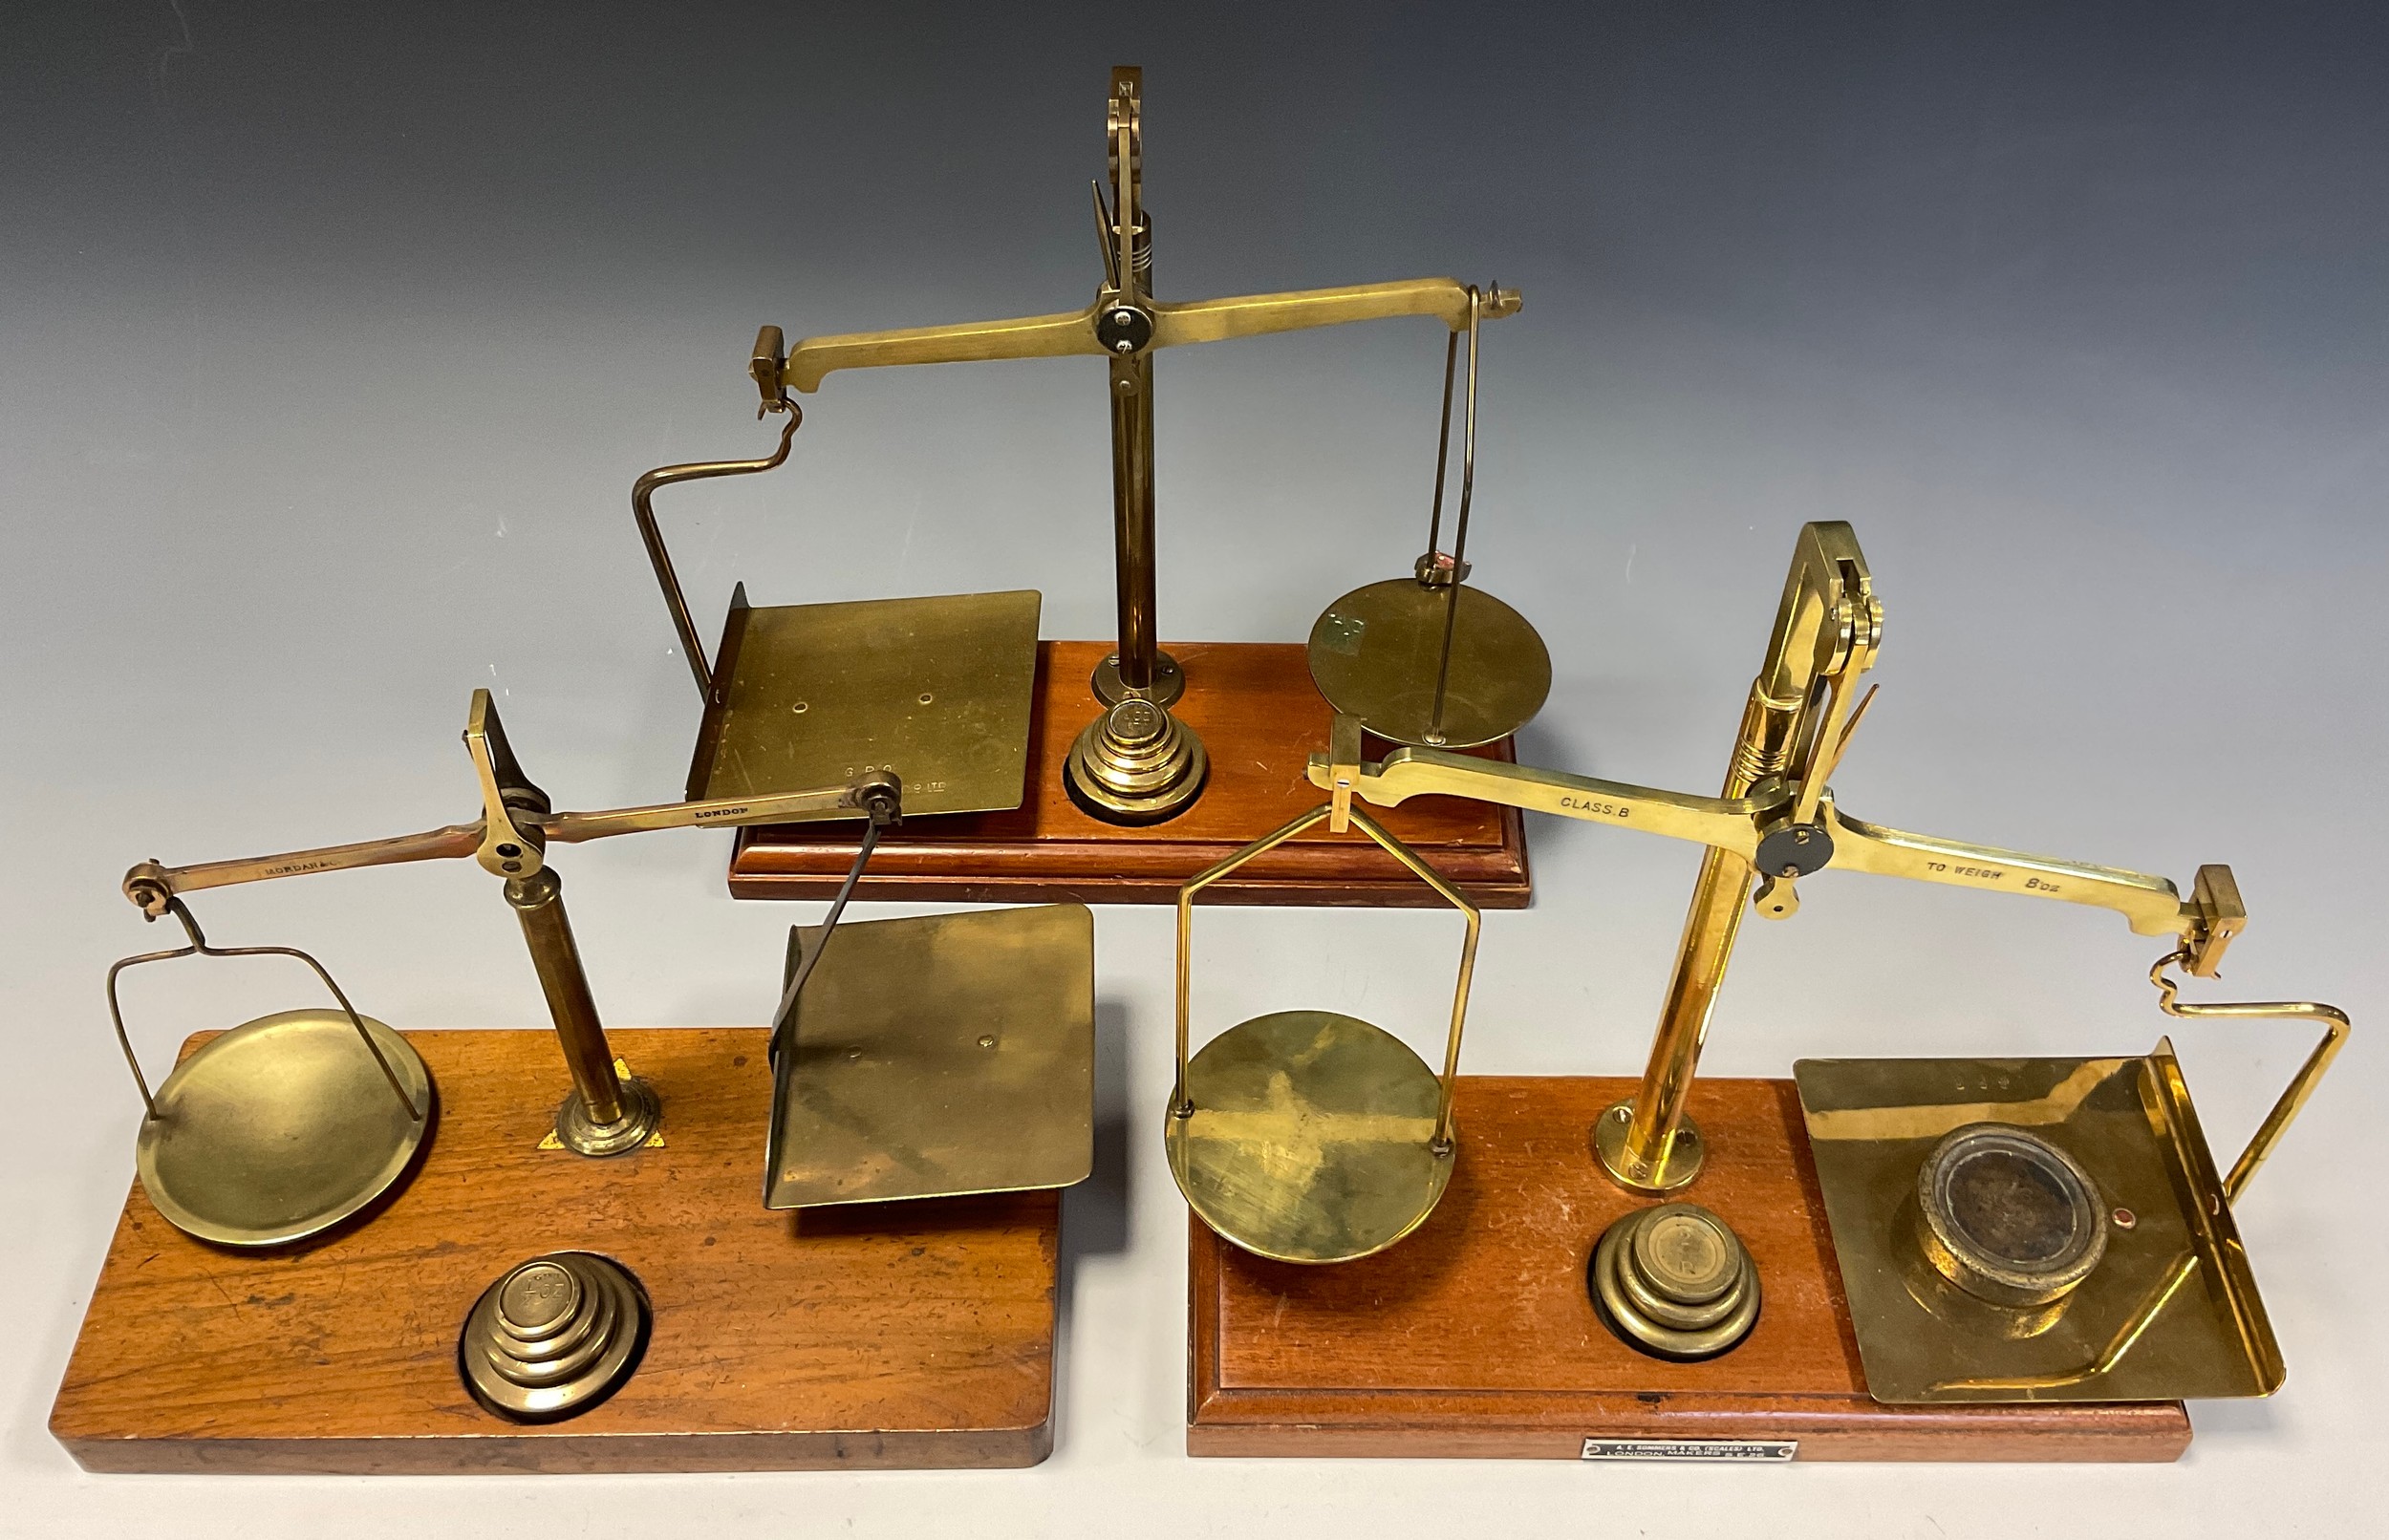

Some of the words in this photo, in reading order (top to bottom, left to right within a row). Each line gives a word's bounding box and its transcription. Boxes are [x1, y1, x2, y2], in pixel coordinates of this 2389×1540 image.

[695, 807, 748, 819] LONDON
[265, 862, 318, 875] MORDAN
[1926, 862, 1947, 872] TO
[1954, 866, 2005, 881] WEIGH
